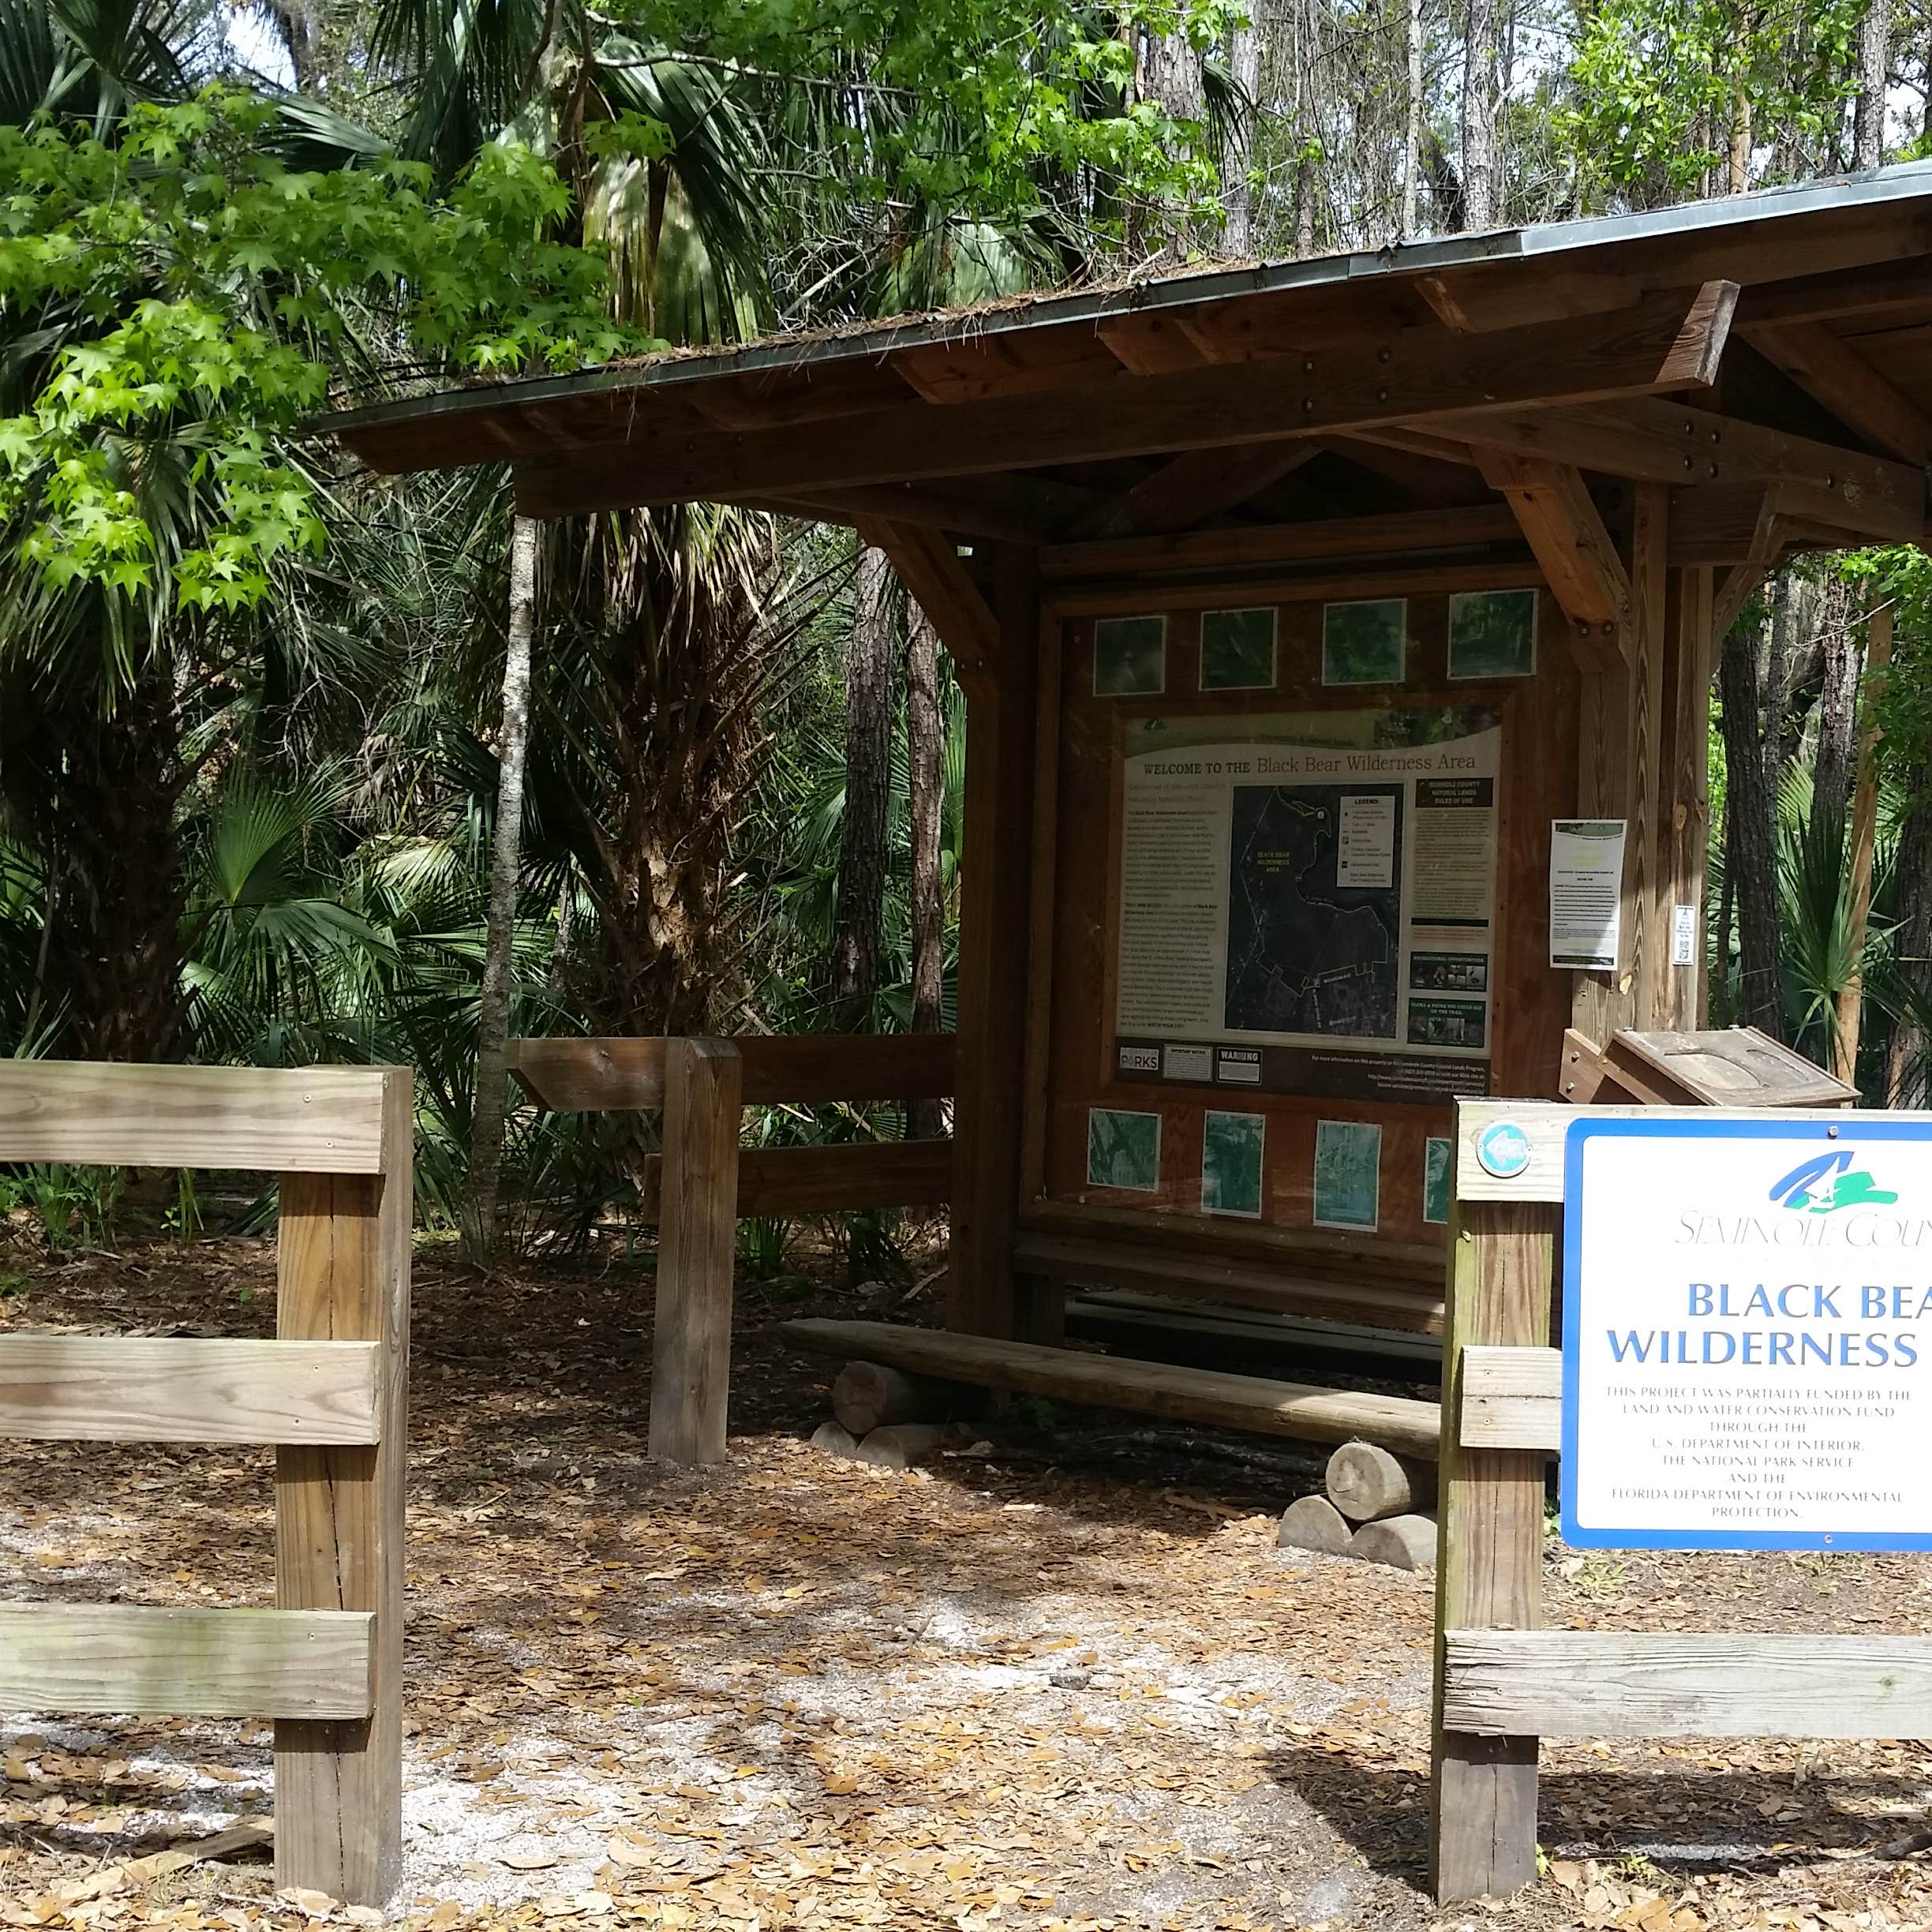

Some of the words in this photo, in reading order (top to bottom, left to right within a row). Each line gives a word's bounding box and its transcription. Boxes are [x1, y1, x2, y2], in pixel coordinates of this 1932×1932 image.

[1144, 762, 1202, 775] WELCOME
[1206, 762, 1222, 774] TO
[1226, 762, 1251, 773] THE
[1257, 757, 1299, 773] Black
[1305, 756, 1342, 773] Bear
[1347, 754, 1432, 771] Wilderness
[1438, 753, 1476, 769] Area
[1221, 1050, 1258, 1062] WARNING
[1688, 1283, 1842, 1319] BLACK
[1860, 1285, 1932, 1320] BEA
[1606, 1330, 1918, 1367] WILDERNESS
[1607, 1386, 1636, 1397] THIS
[1641, 1387, 1697, 1398] PROJECT
[1702, 1387, 1732, 1398] WAS
[1736, 1388, 1800, 1399] PARTIALLY
[1807, 1389, 1863, 1400] FUNDED
[1867, 1389, 1881, 1400] BY
[1889, 1390, 1913, 1401] THE
[1623, 1403, 1660, 1414] LAND
[1664, 1404, 1694, 1414] AND
[1698, 1404, 1743, 1415] WATER
[1747, 1405, 1852, 1417] CONSERVATION
[1857, 1406, 1895, 1417] FUND
[1709, 1421, 1779, 1432] THROUGH
[1784, 1422, 1809, 1433] THE
[1652, 1437, 1677, 1449] U.S.
[1682, 1439, 1769, 1450] DEPARTMENT
[1774, 1440, 1792, 1451] OF
[1662, 1455, 1686, 1466] THE
[1691, 1455, 1758, 1466] NATIONAL
[1764, 1457, 1797, 1467] PARK
[1802, 1457, 1855, 1468] SERVICE
[1728, 1473, 1758, 1484] AND
[1763, 1473, 1787, 1484] THE
[1612, 1488, 1669, 1500] FLORIDA
[1674, 1489, 1761, 1500] DEPARTMENT
[1766, 1491, 1783, 1501] OF
[1789, 1490, 1904, 1503] ENVIRONMENTAL
